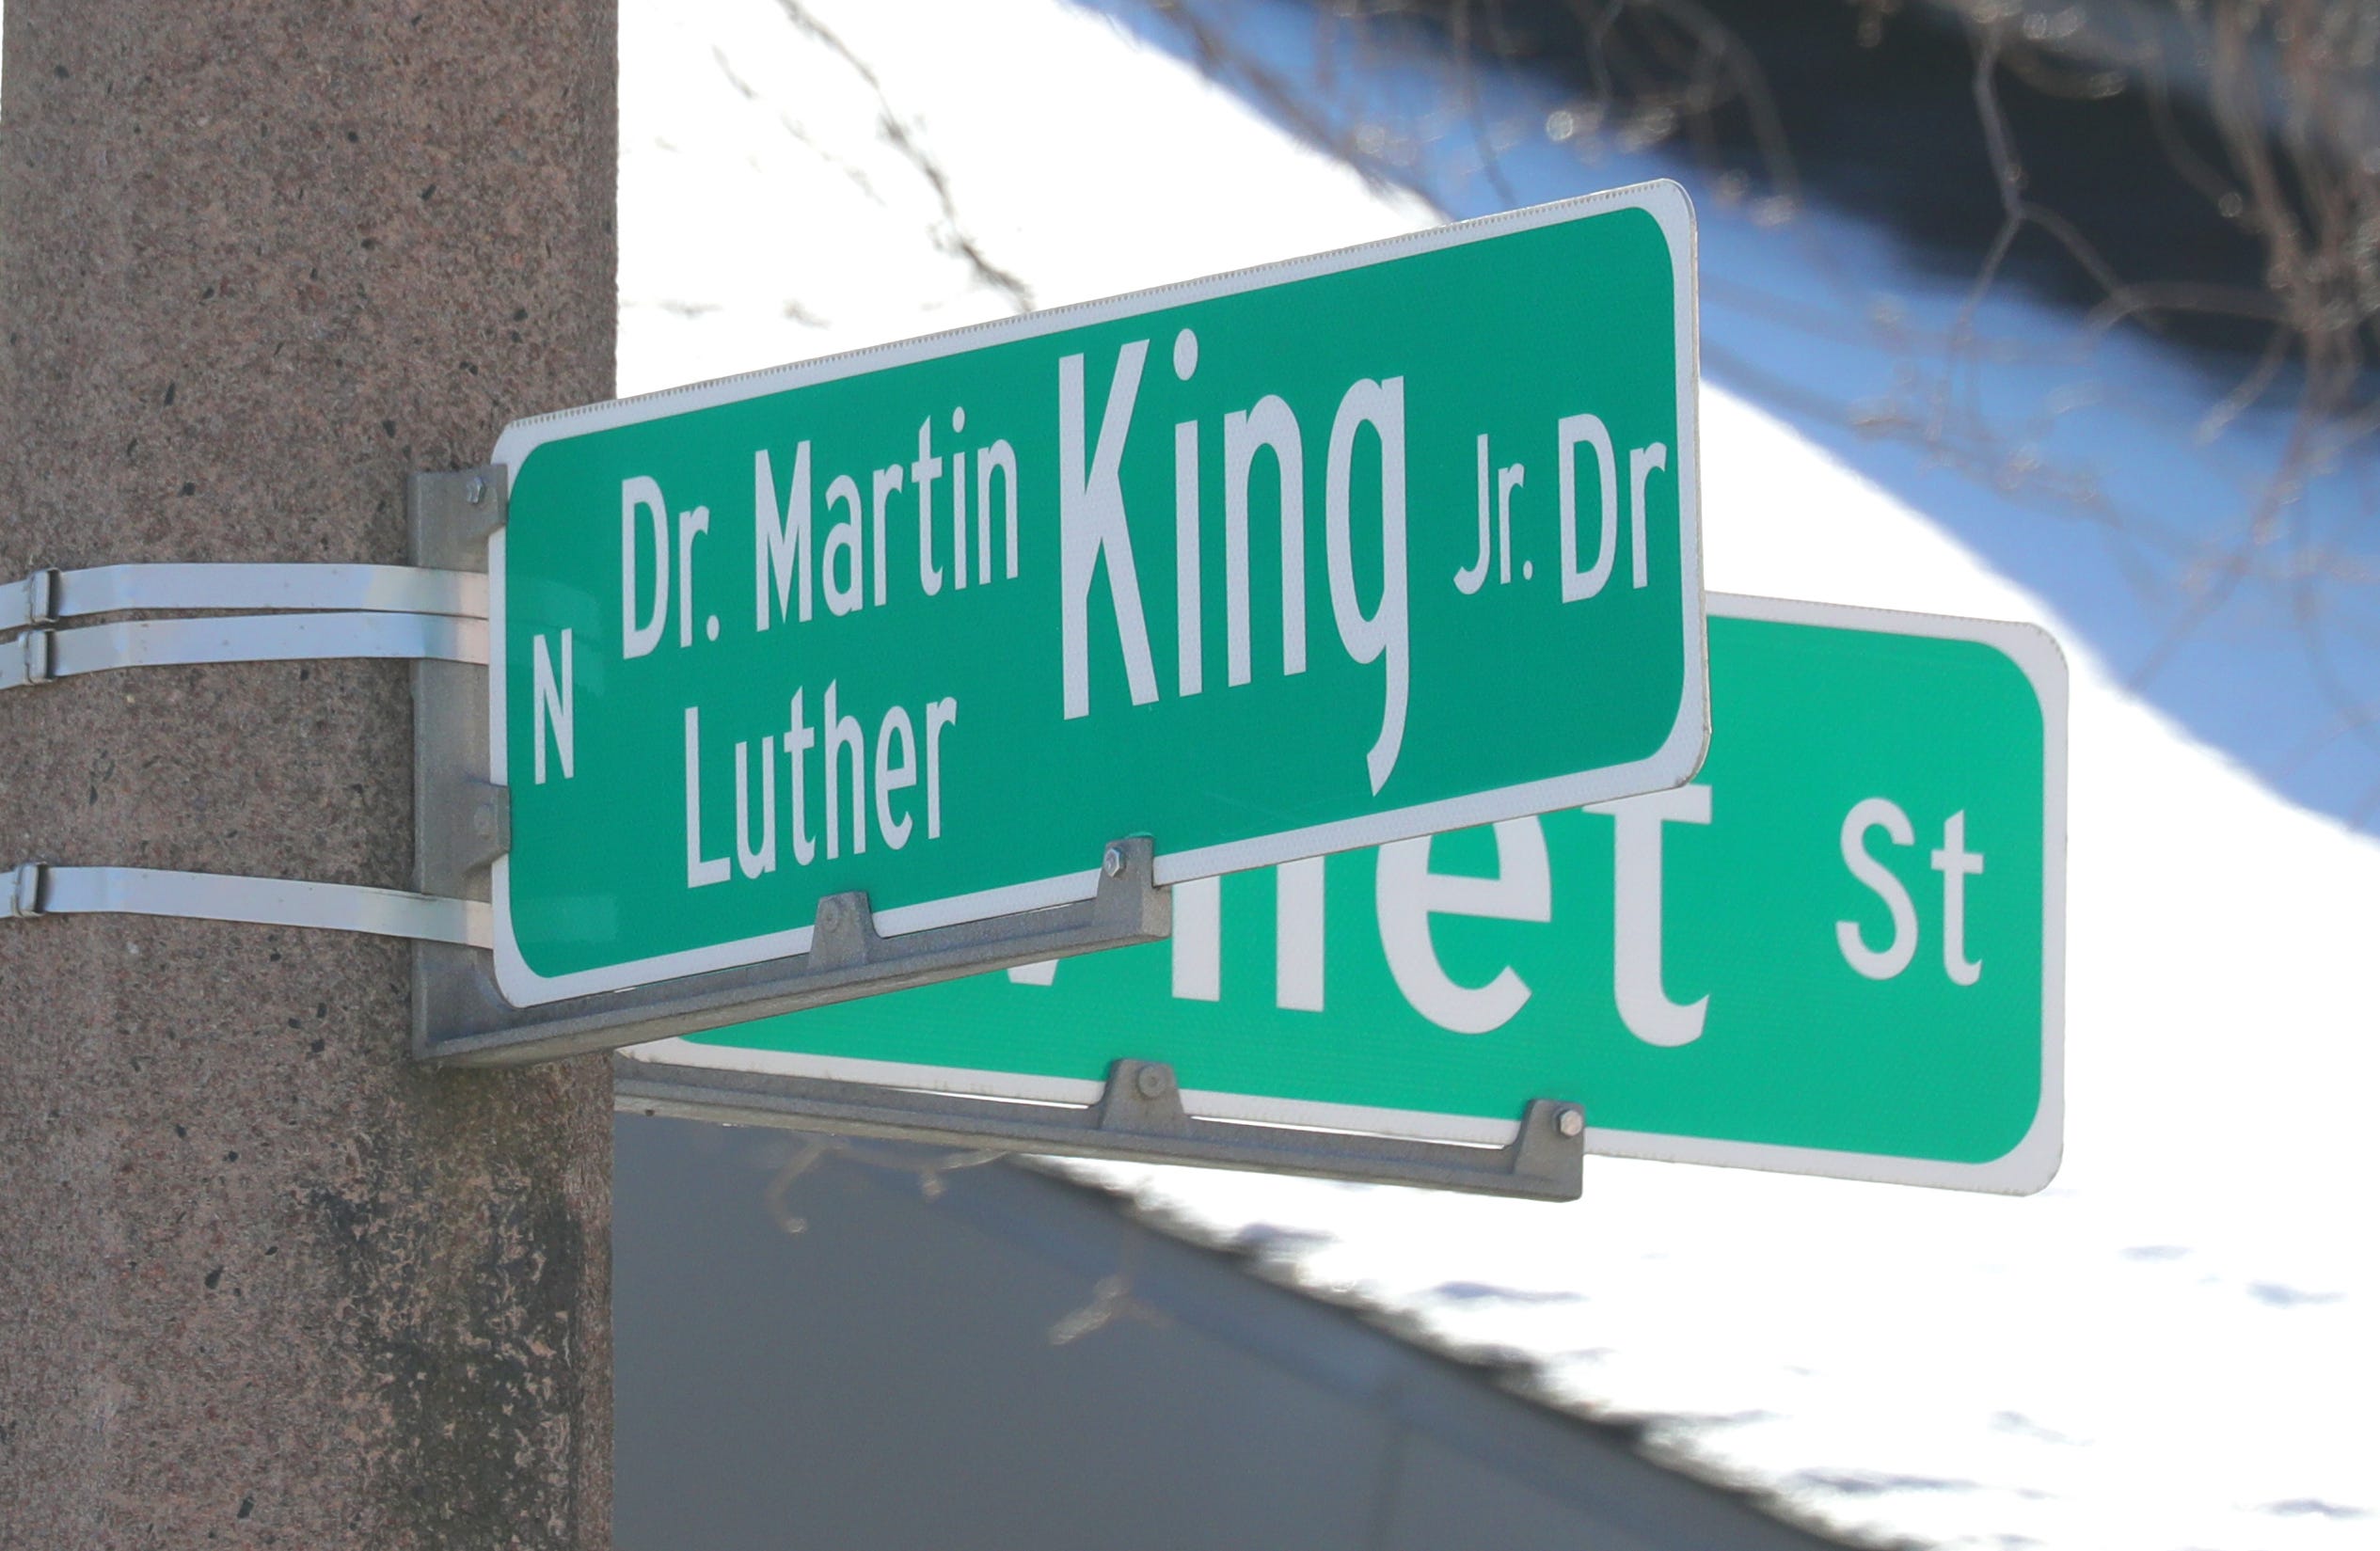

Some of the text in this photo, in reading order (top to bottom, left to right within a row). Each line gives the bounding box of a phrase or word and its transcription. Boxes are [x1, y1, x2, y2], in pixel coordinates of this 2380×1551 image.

[622, 406, 1018, 658] Dr. Martin
[1058, 327, 1668, 796] King Jr. Dr
[533, 628, 575, 784] N
[685, 679, 958, 889] Luther
[1835, 797, 1985, 986] St
